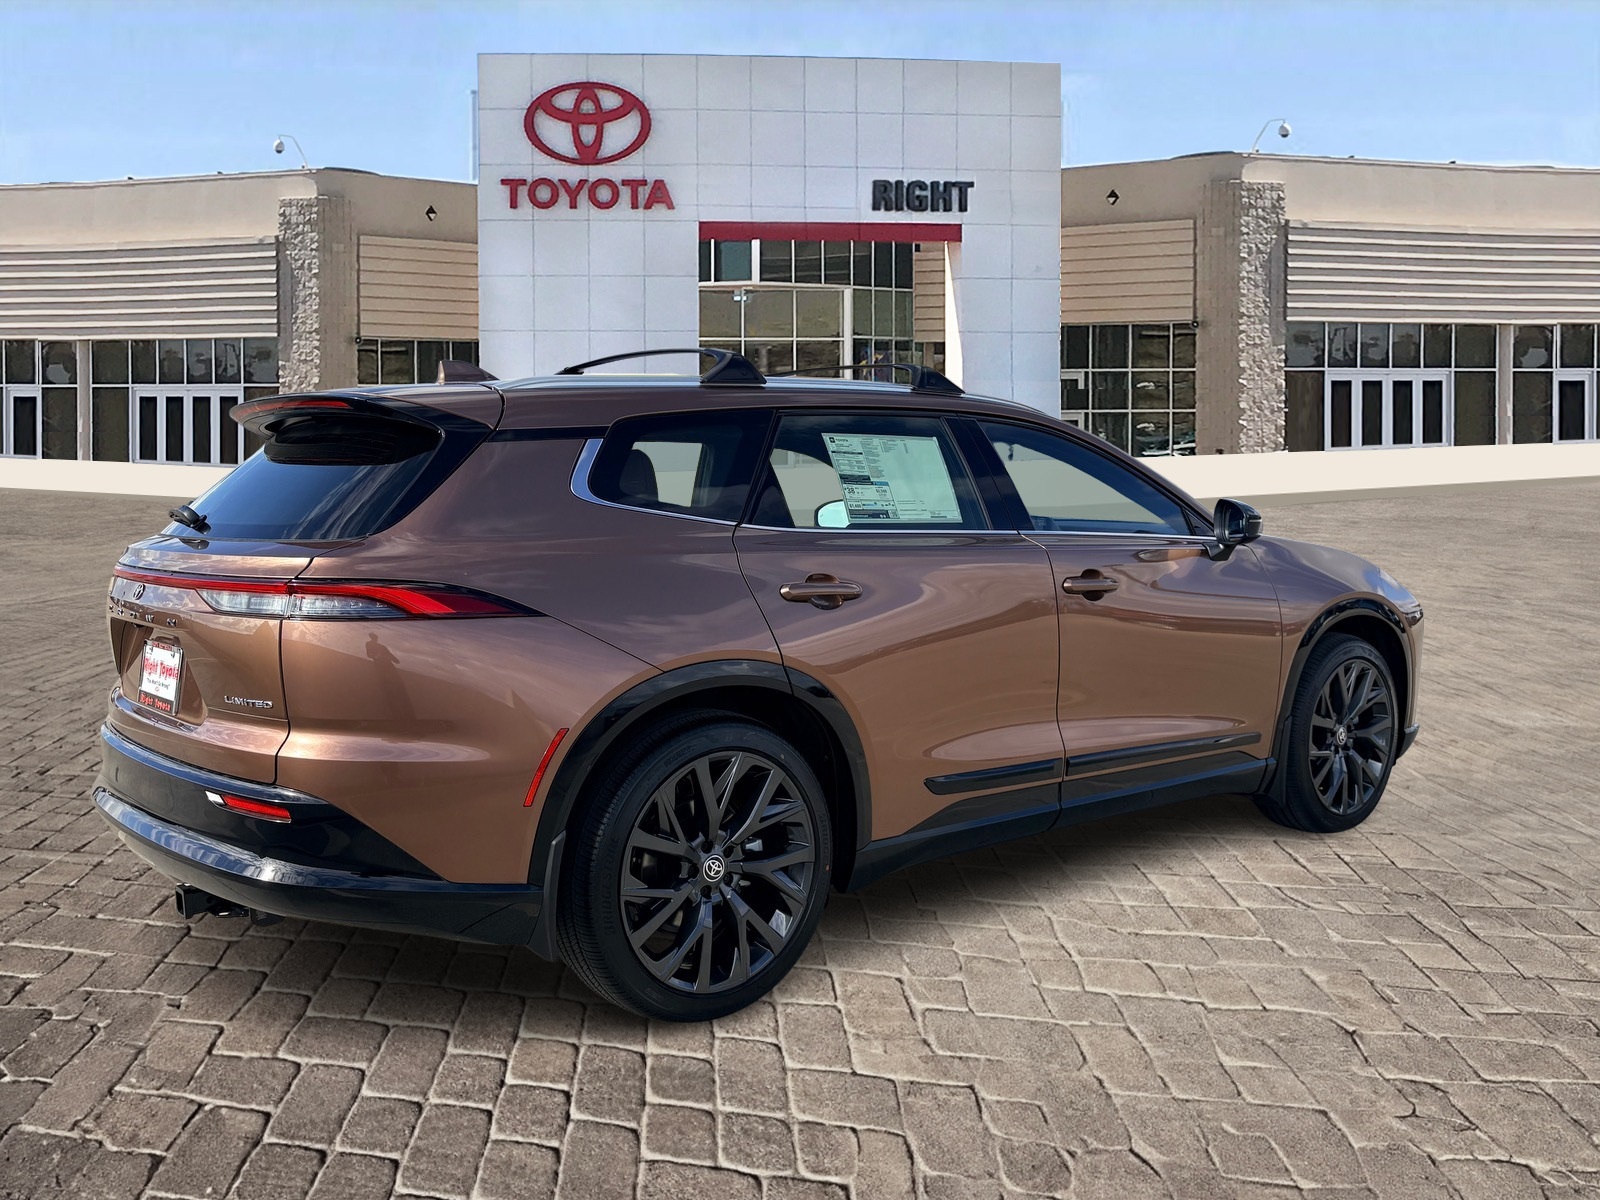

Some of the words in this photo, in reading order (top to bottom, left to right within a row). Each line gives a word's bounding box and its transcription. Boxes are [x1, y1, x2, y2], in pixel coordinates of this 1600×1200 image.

[500, 179, 675, 210] TOYOTA
[872, 180, 975, 213] RIGHT
[159, 661, 179, 680] Toyota
[223, 695, 273, 709] LIMITED
